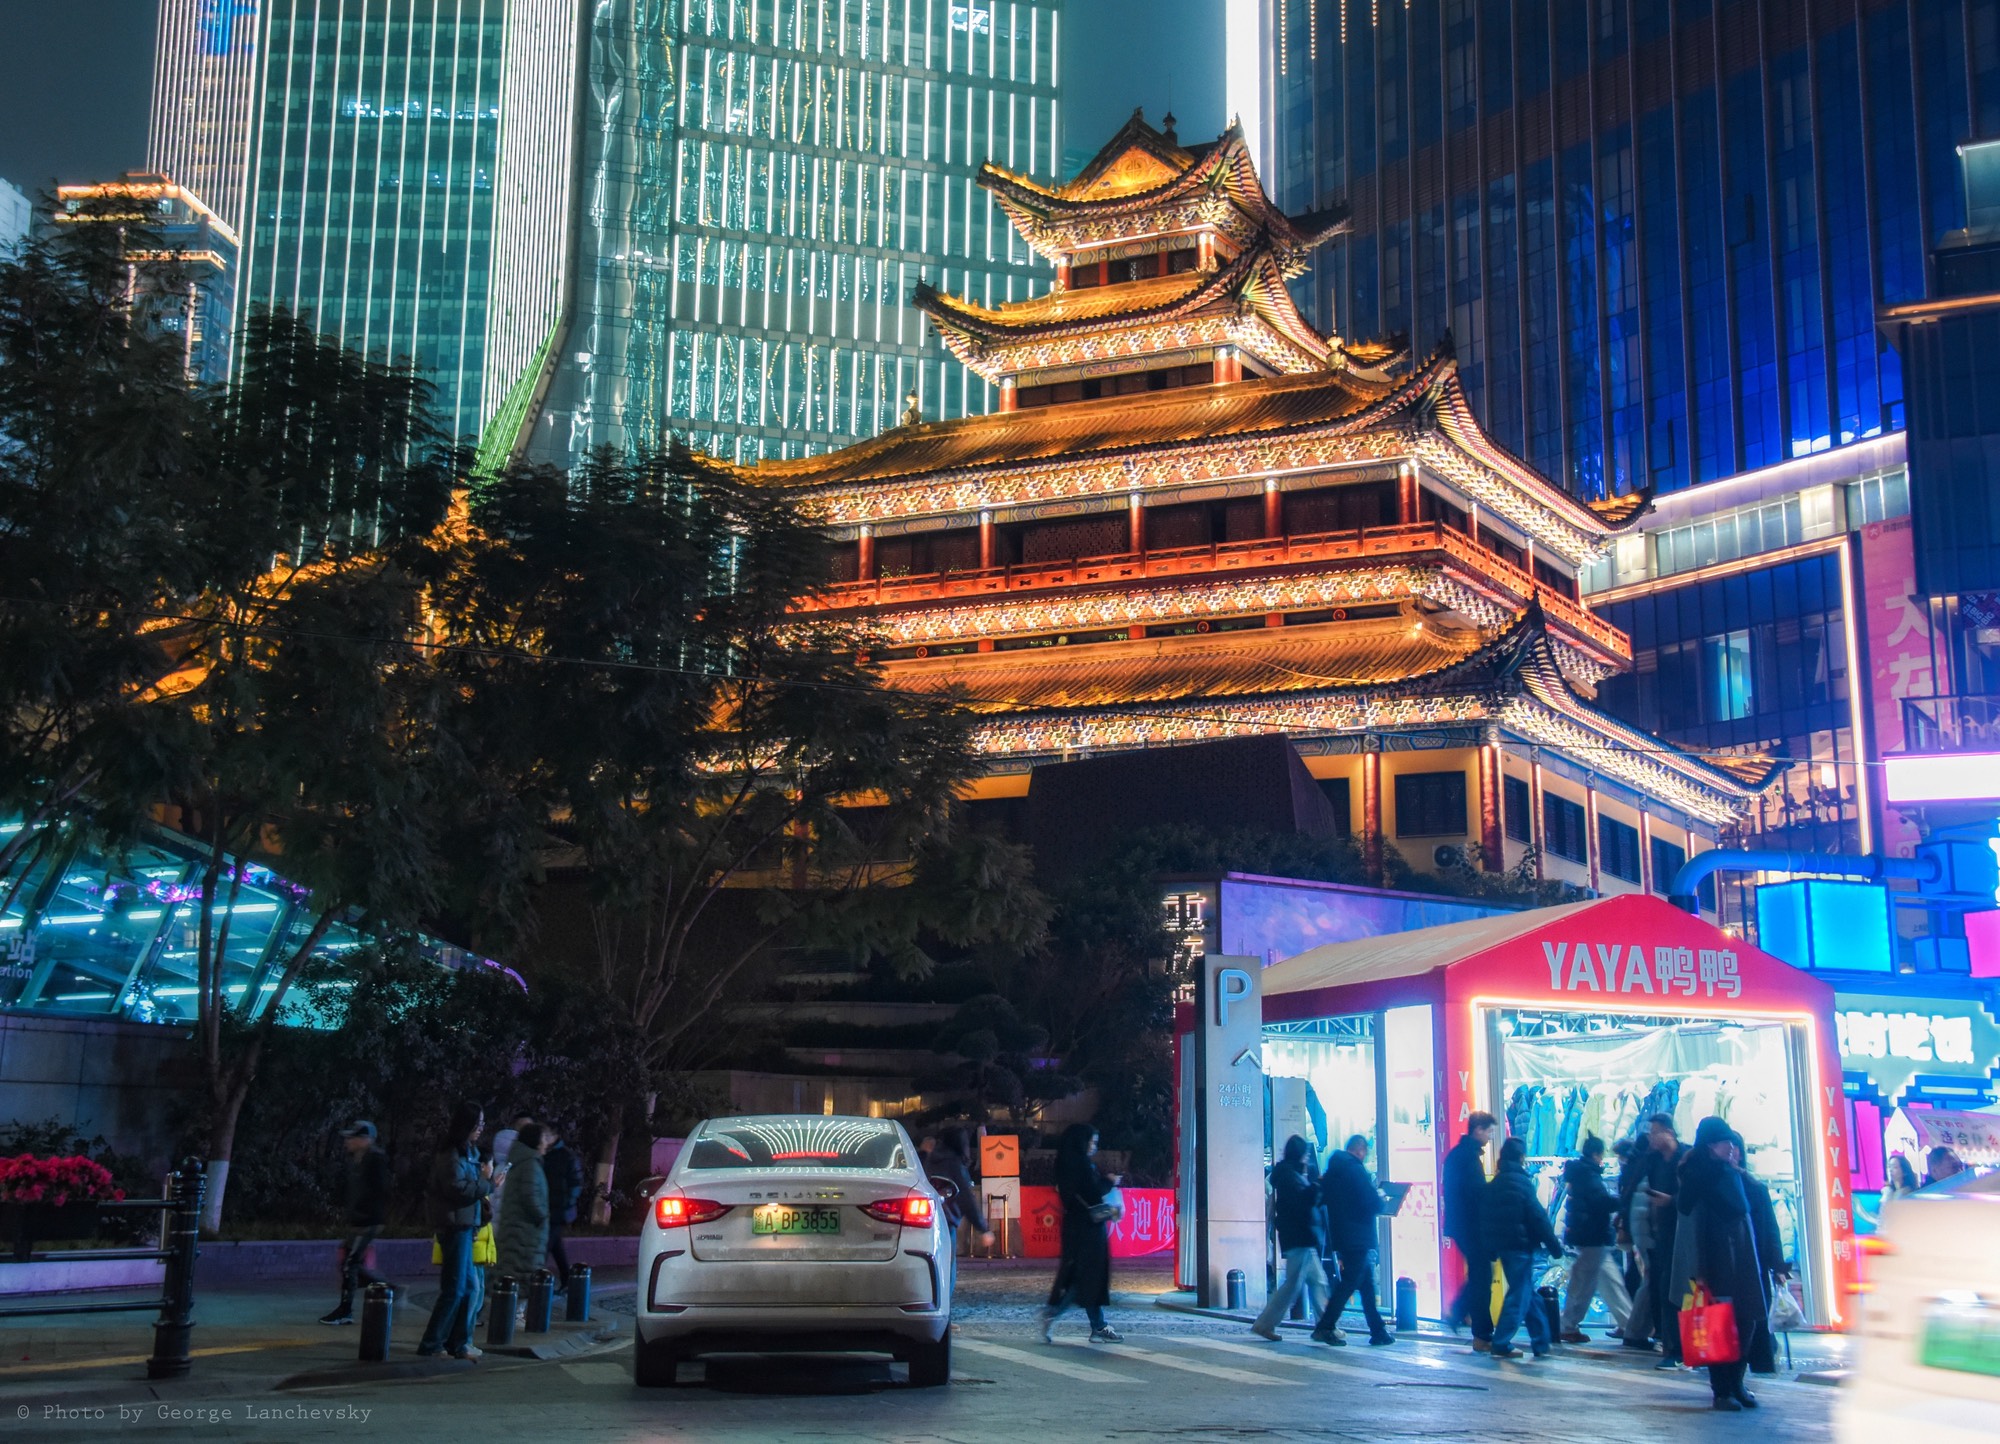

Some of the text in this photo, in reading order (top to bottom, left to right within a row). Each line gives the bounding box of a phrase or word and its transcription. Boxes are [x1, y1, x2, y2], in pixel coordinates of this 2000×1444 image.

[1541, 941, 1741, 998] YAYA鸭鸭
[1219, 968, 1253, 1027] P
[1219, 1083, 1251, 1094] 24小时
[1219, 1095, 1251, 1107] 停车场
[781, 1211, 838, 1231] BP3855
